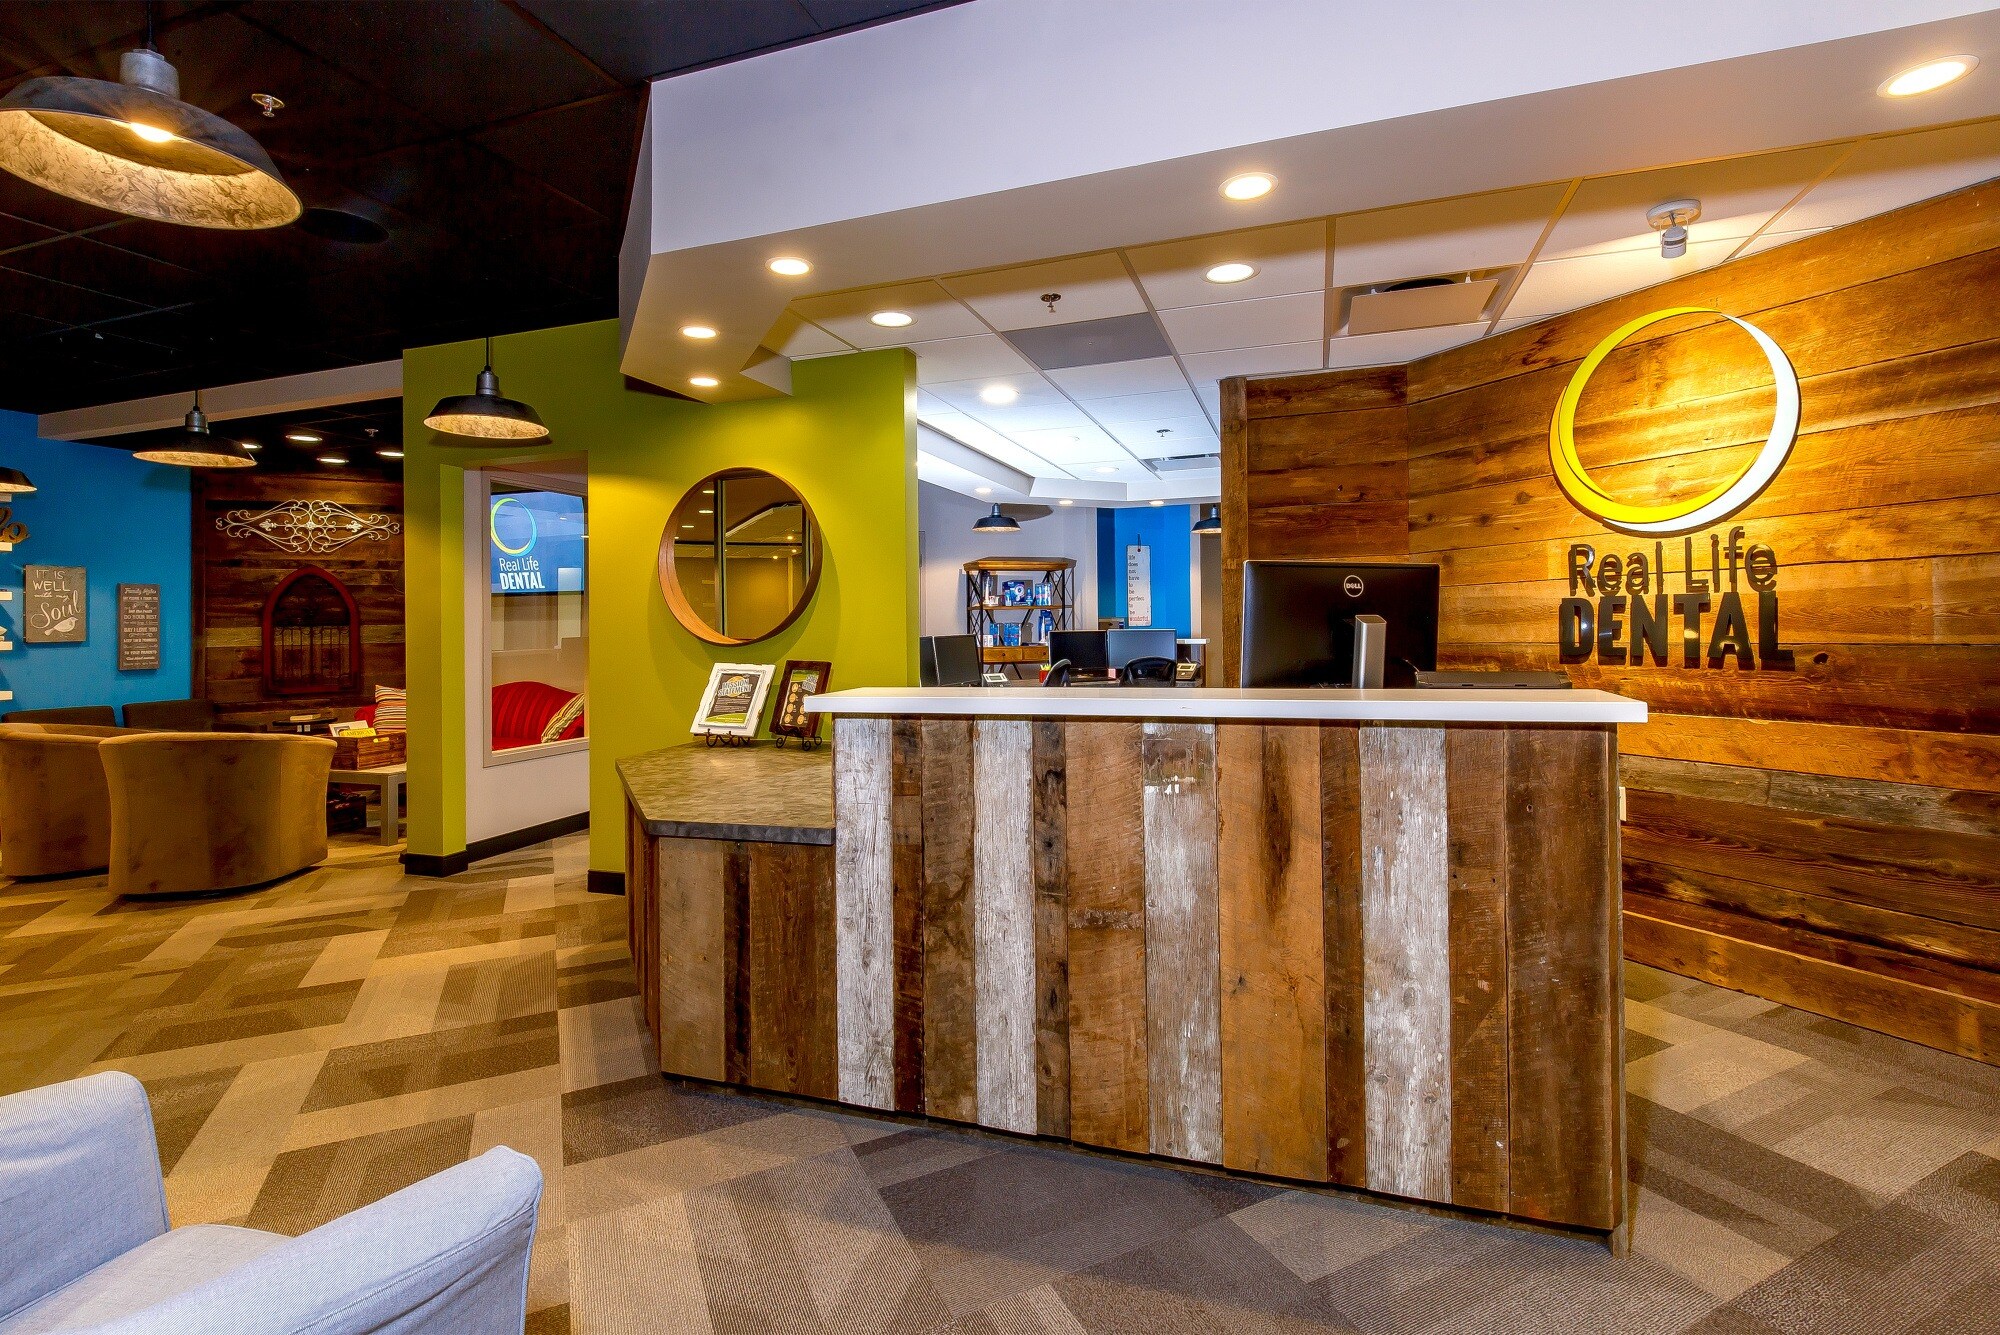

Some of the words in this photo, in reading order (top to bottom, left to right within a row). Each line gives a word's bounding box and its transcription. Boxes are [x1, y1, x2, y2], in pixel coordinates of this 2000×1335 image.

[499, 556, 520, 572] Real
[522, 555, 540, 571] Life
[1568, 541, 1665, 597] Real
[1684, 525, 1778, 594] Life
[36, 569, 49, 578] IT
[54, 570, 66, 580] IS
[499, 571, 546, 590] DENTAL
[32, 580, 71, 592] WELL
[1128, 595, 1145, 603] perfect
[30, 589, 81, 629] Soul
[1558, 590, 1796, 671] DENTAL
[718, 684, 753, 697] STATEMENT
[721, 678, 750, 690] MISSION
